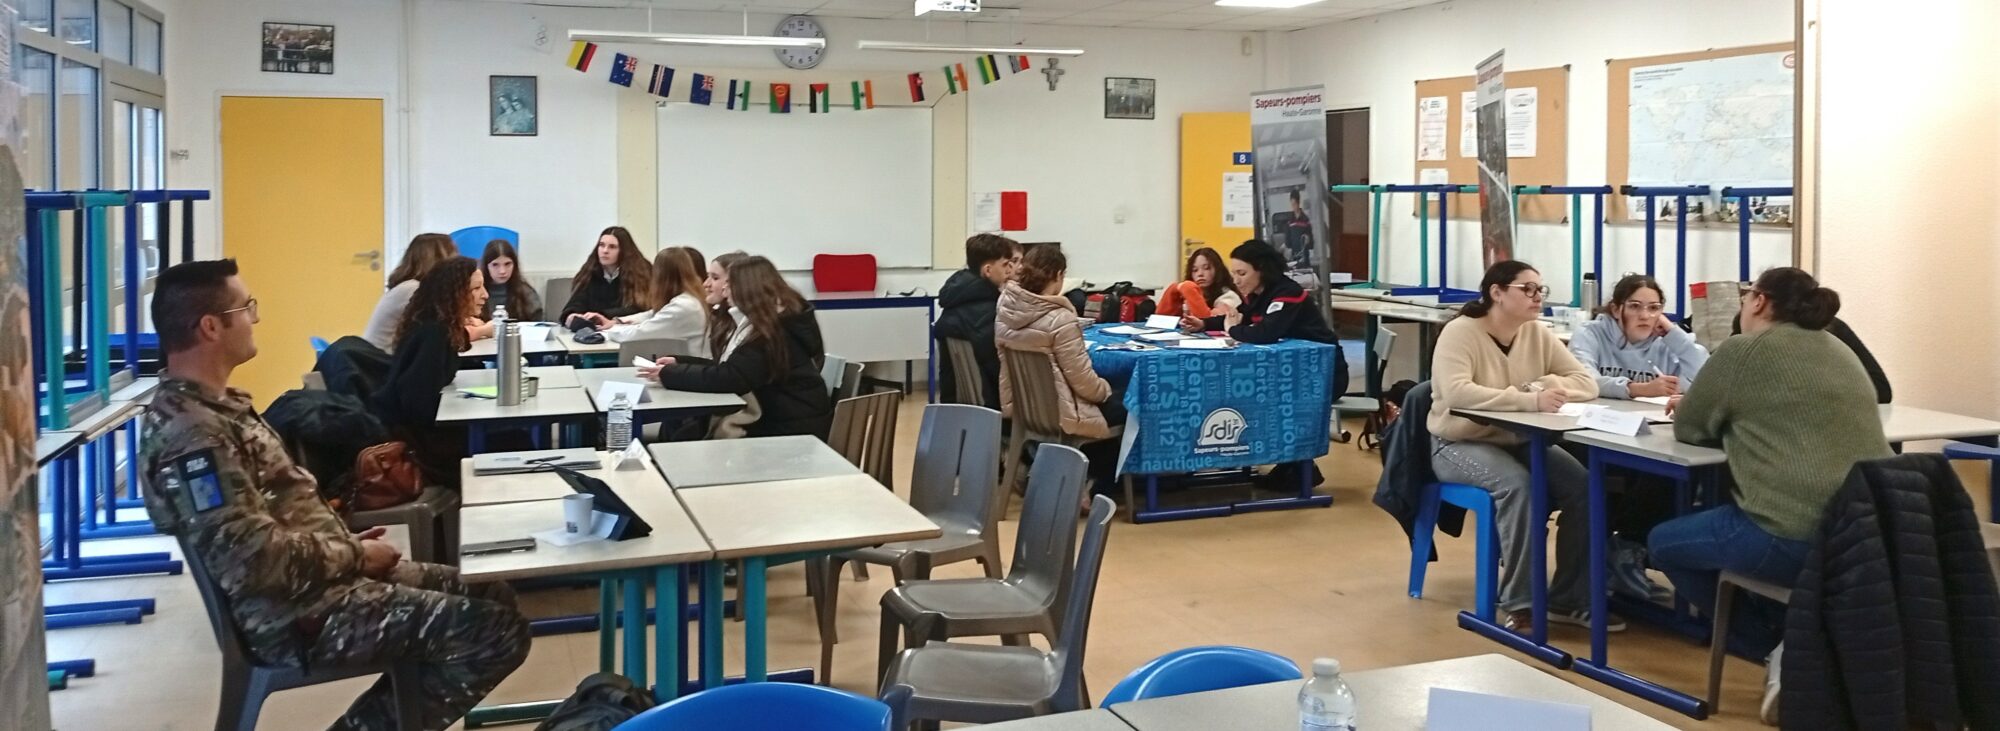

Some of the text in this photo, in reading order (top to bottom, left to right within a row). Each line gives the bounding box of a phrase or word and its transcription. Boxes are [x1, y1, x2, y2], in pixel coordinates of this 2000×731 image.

[1255, 93, 1322, 109] Sapeurs-pompiers
[1238, 153, 1247, 164] 8
[1232, 363, 1255, 398] 18
[1205, 420, 1240, 440] sdis
[1142, 456, 1214, 472] nautique
